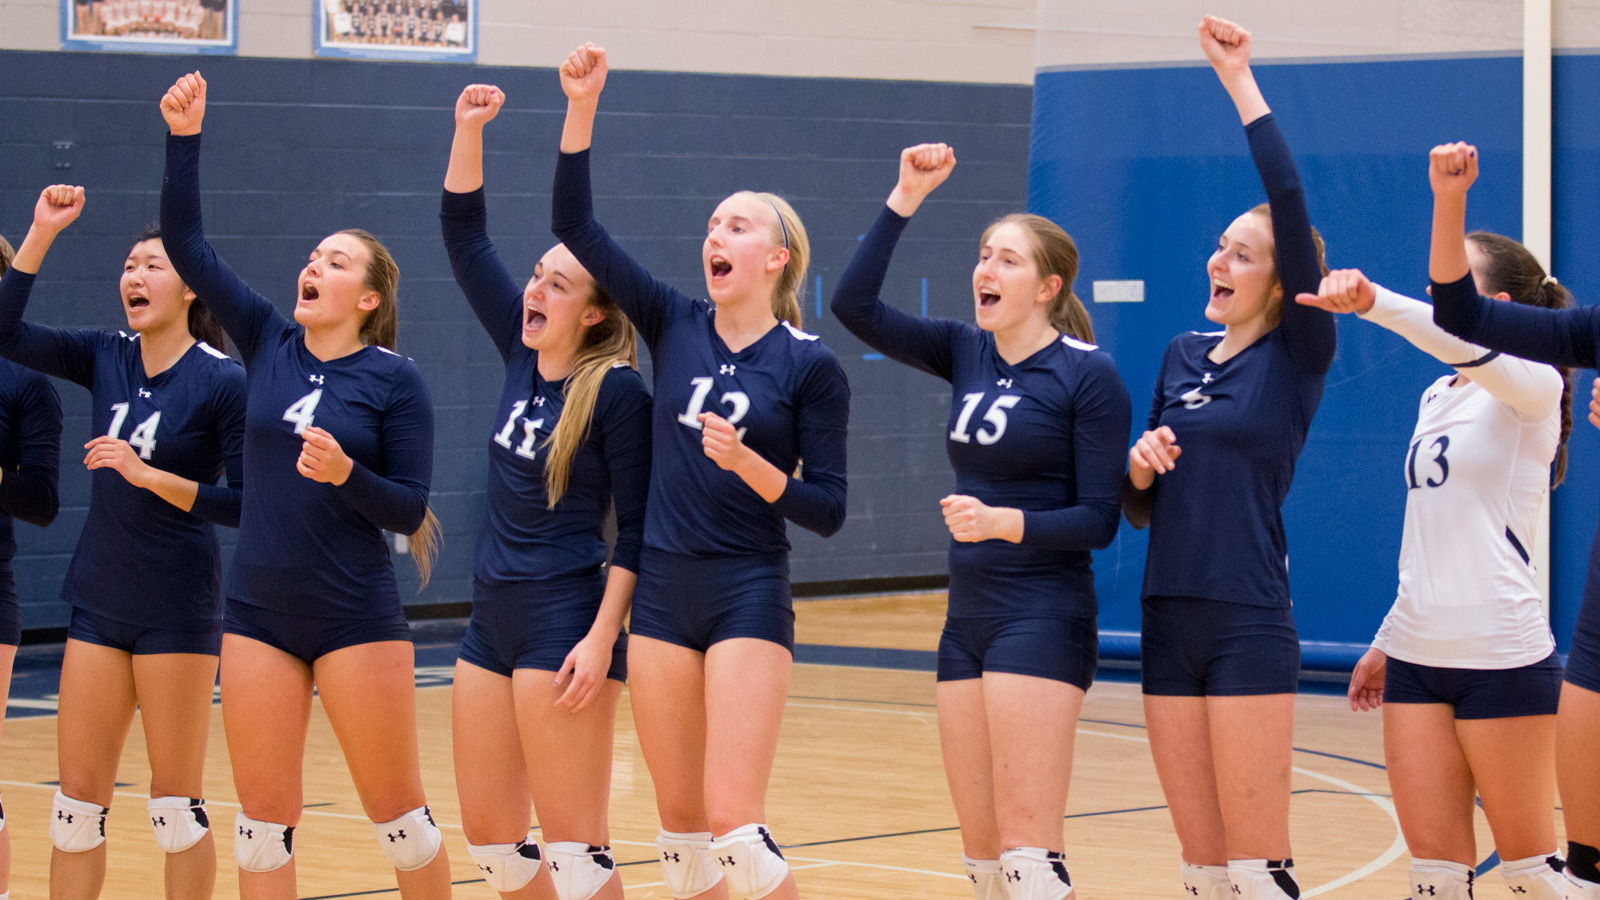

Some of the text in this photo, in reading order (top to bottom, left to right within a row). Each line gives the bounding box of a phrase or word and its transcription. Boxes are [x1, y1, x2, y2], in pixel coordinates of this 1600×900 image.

[107, 401, 162, 460] 14
[282, 388, 323, 434] 4
[493, 399, 544, 460] 11
[678, 376, 751, 442] 12
[949, 391, 1022, 446] 15
[1408, 435, 1450, 490] 13
